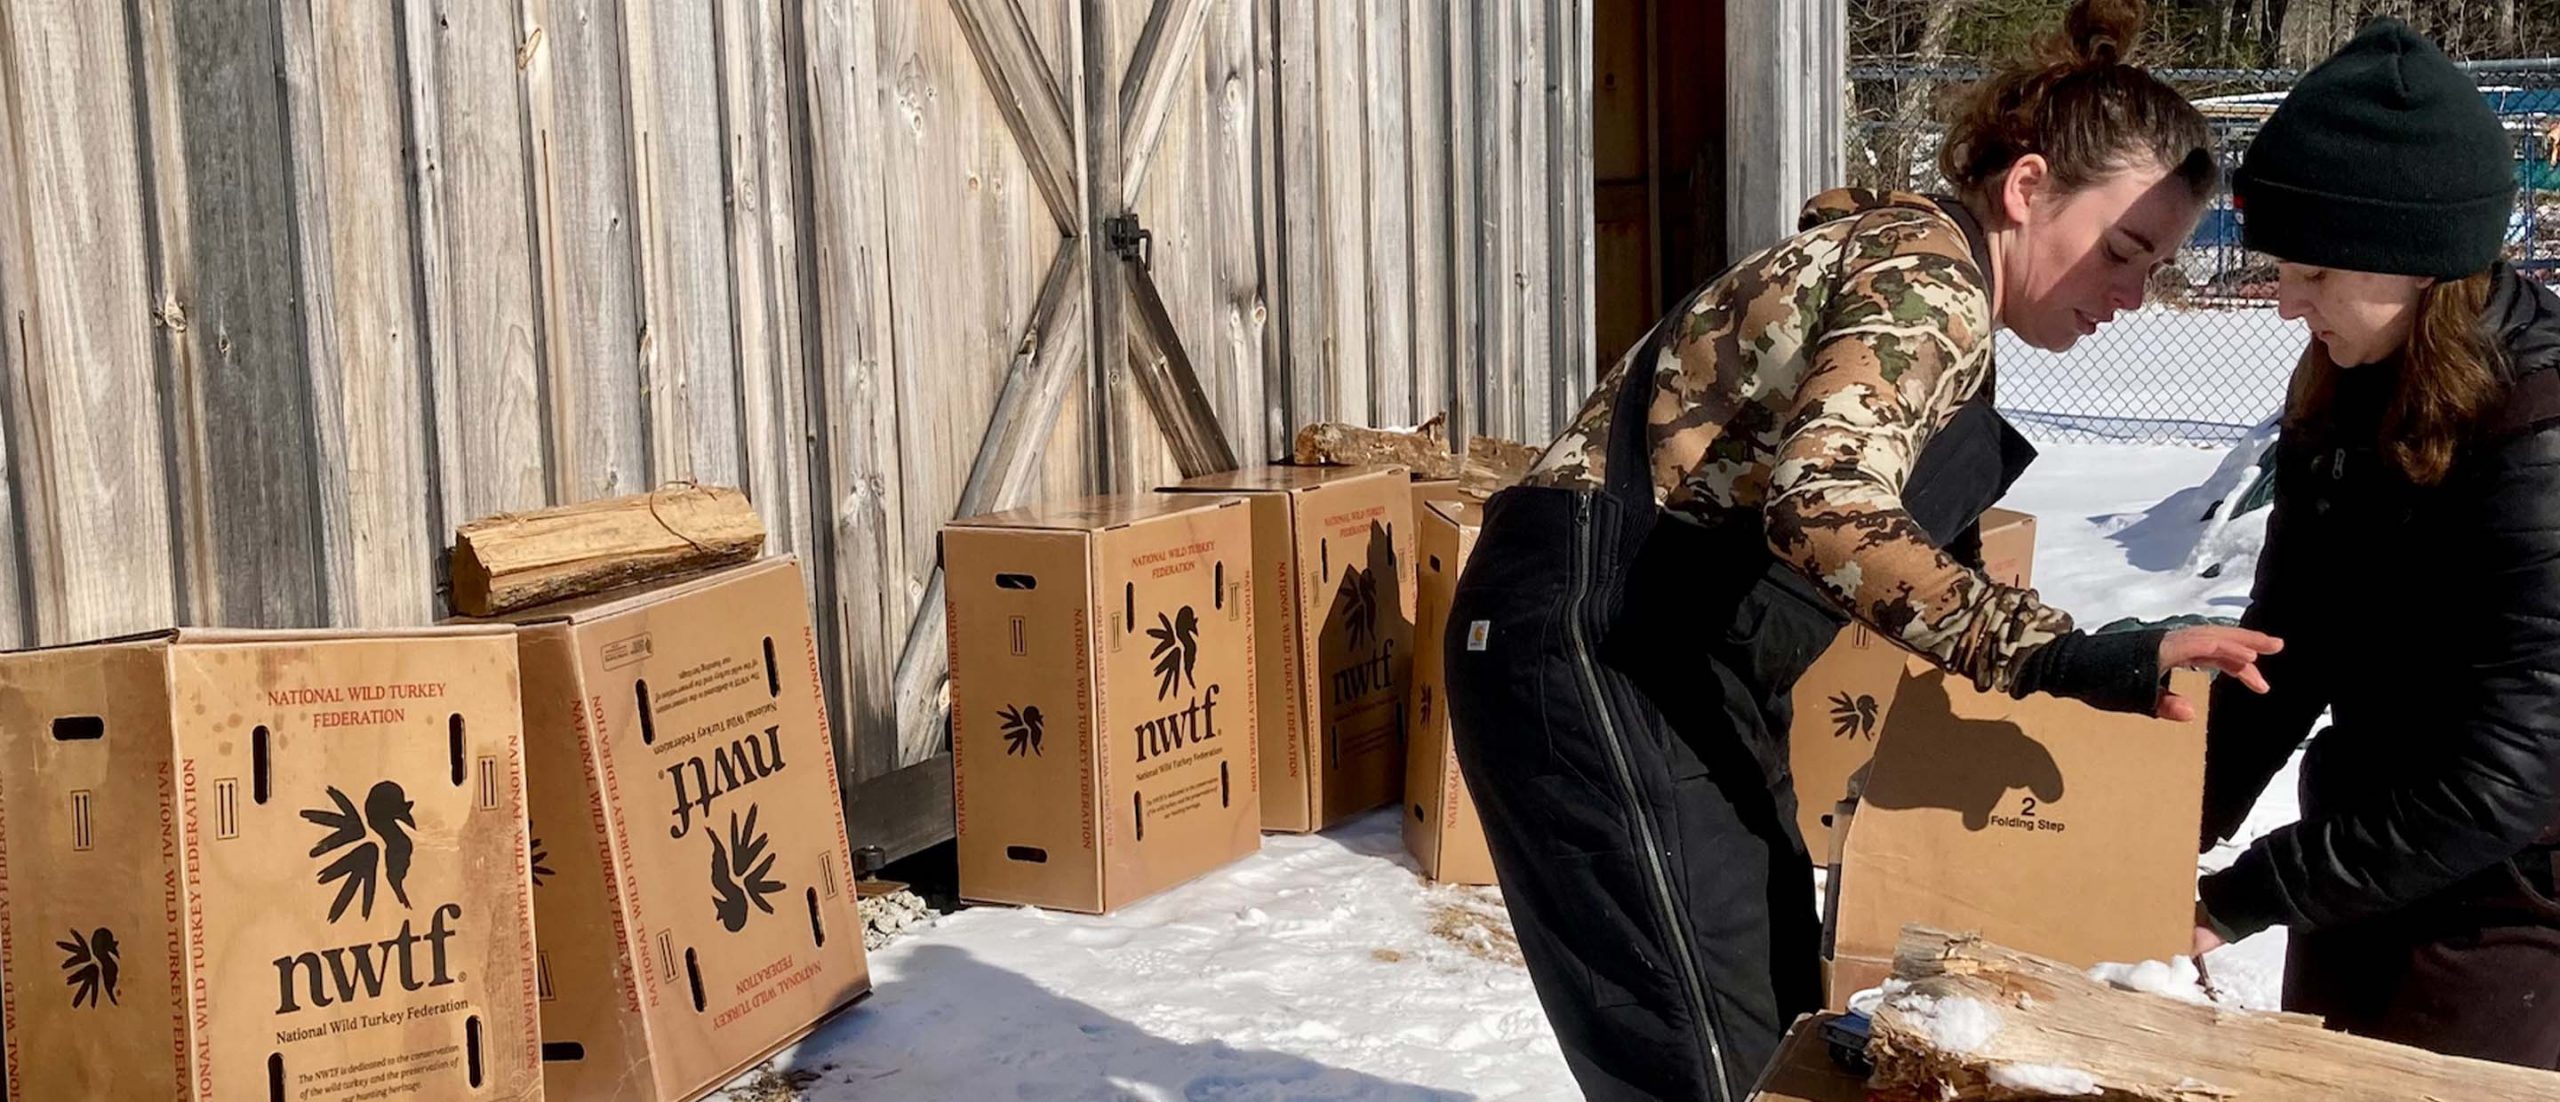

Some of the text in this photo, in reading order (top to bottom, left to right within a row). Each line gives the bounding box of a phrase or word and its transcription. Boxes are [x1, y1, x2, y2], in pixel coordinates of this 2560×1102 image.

[1244, 570, 1253, 632] NATIONAL
[1279, 561, 1289, 620] NATIONAL
[1282, 623, 1291, 653] WILD
[267, 682, 446, 706] NATIONAL WILD TURKEY
[1332, 638, 1393, 705] nwtf
[313, 708, 405, 729] FEDERATION
[697, 721, 725, 737] Turkey
[803, 626, 822, 703] NATIONAL
[817, 707, 829, 745] WILD
[824, 751, 839, 807] TURKEY
[1074, 608, 1091, 849] NATIONAL WILD TURKEY FEDERATION
[1134, 683, 1219, 763] nwtf
[508, 735, 522, 825] NATIONAL
[666, 724, 786, 838] nwtf
[953, 735, 963, 769] WILD
[570, 700, 596, 787] NATIONAL
[589, 791, 606, 834] WILD
[598, 838, 621, 906] TURKEY
[955, 772, 967, 837] NATIONAL
[1991, 816, 2065, 834] Folding Step
[2021, 797, 2036, 816] 2
[514, 831, 525, 876] WILD
[613, 805, 633, 872] TURKEY
[627, 875, 642, 919] WILD
[0, 899, 13, 973] TURKEY
[158, 761, 187, 1102] NATIONAL WILD TURKEY FEDERAT
[183, 758, 212, 1101] IONAL WILD TURKEY FEDERATION
[273, 903, 462, 1015] nwtf
[637, 922, 659, 1007] NATIONAL
[713, 960, 822, 1031] NATIONAL WILD TURKEY
[736, 954, 793, 996] FEDERATION
[4, 981, 16, 1031] WILD
[276, 1000, 469, 1045] National Wild Turkey Federation
[8, 1036, 20, 1101] IONAL
[299, 1074, 313, 1084] The
[299, 1088, 309, 1101] of
[310, 1086, 323, 1097] the
[324, 1081, 342, 1093] wild
[343, 1078, 368, 1090] turkey
[370, 1074, 385, 1084] and
[386, 1069, 399, 1081] the
